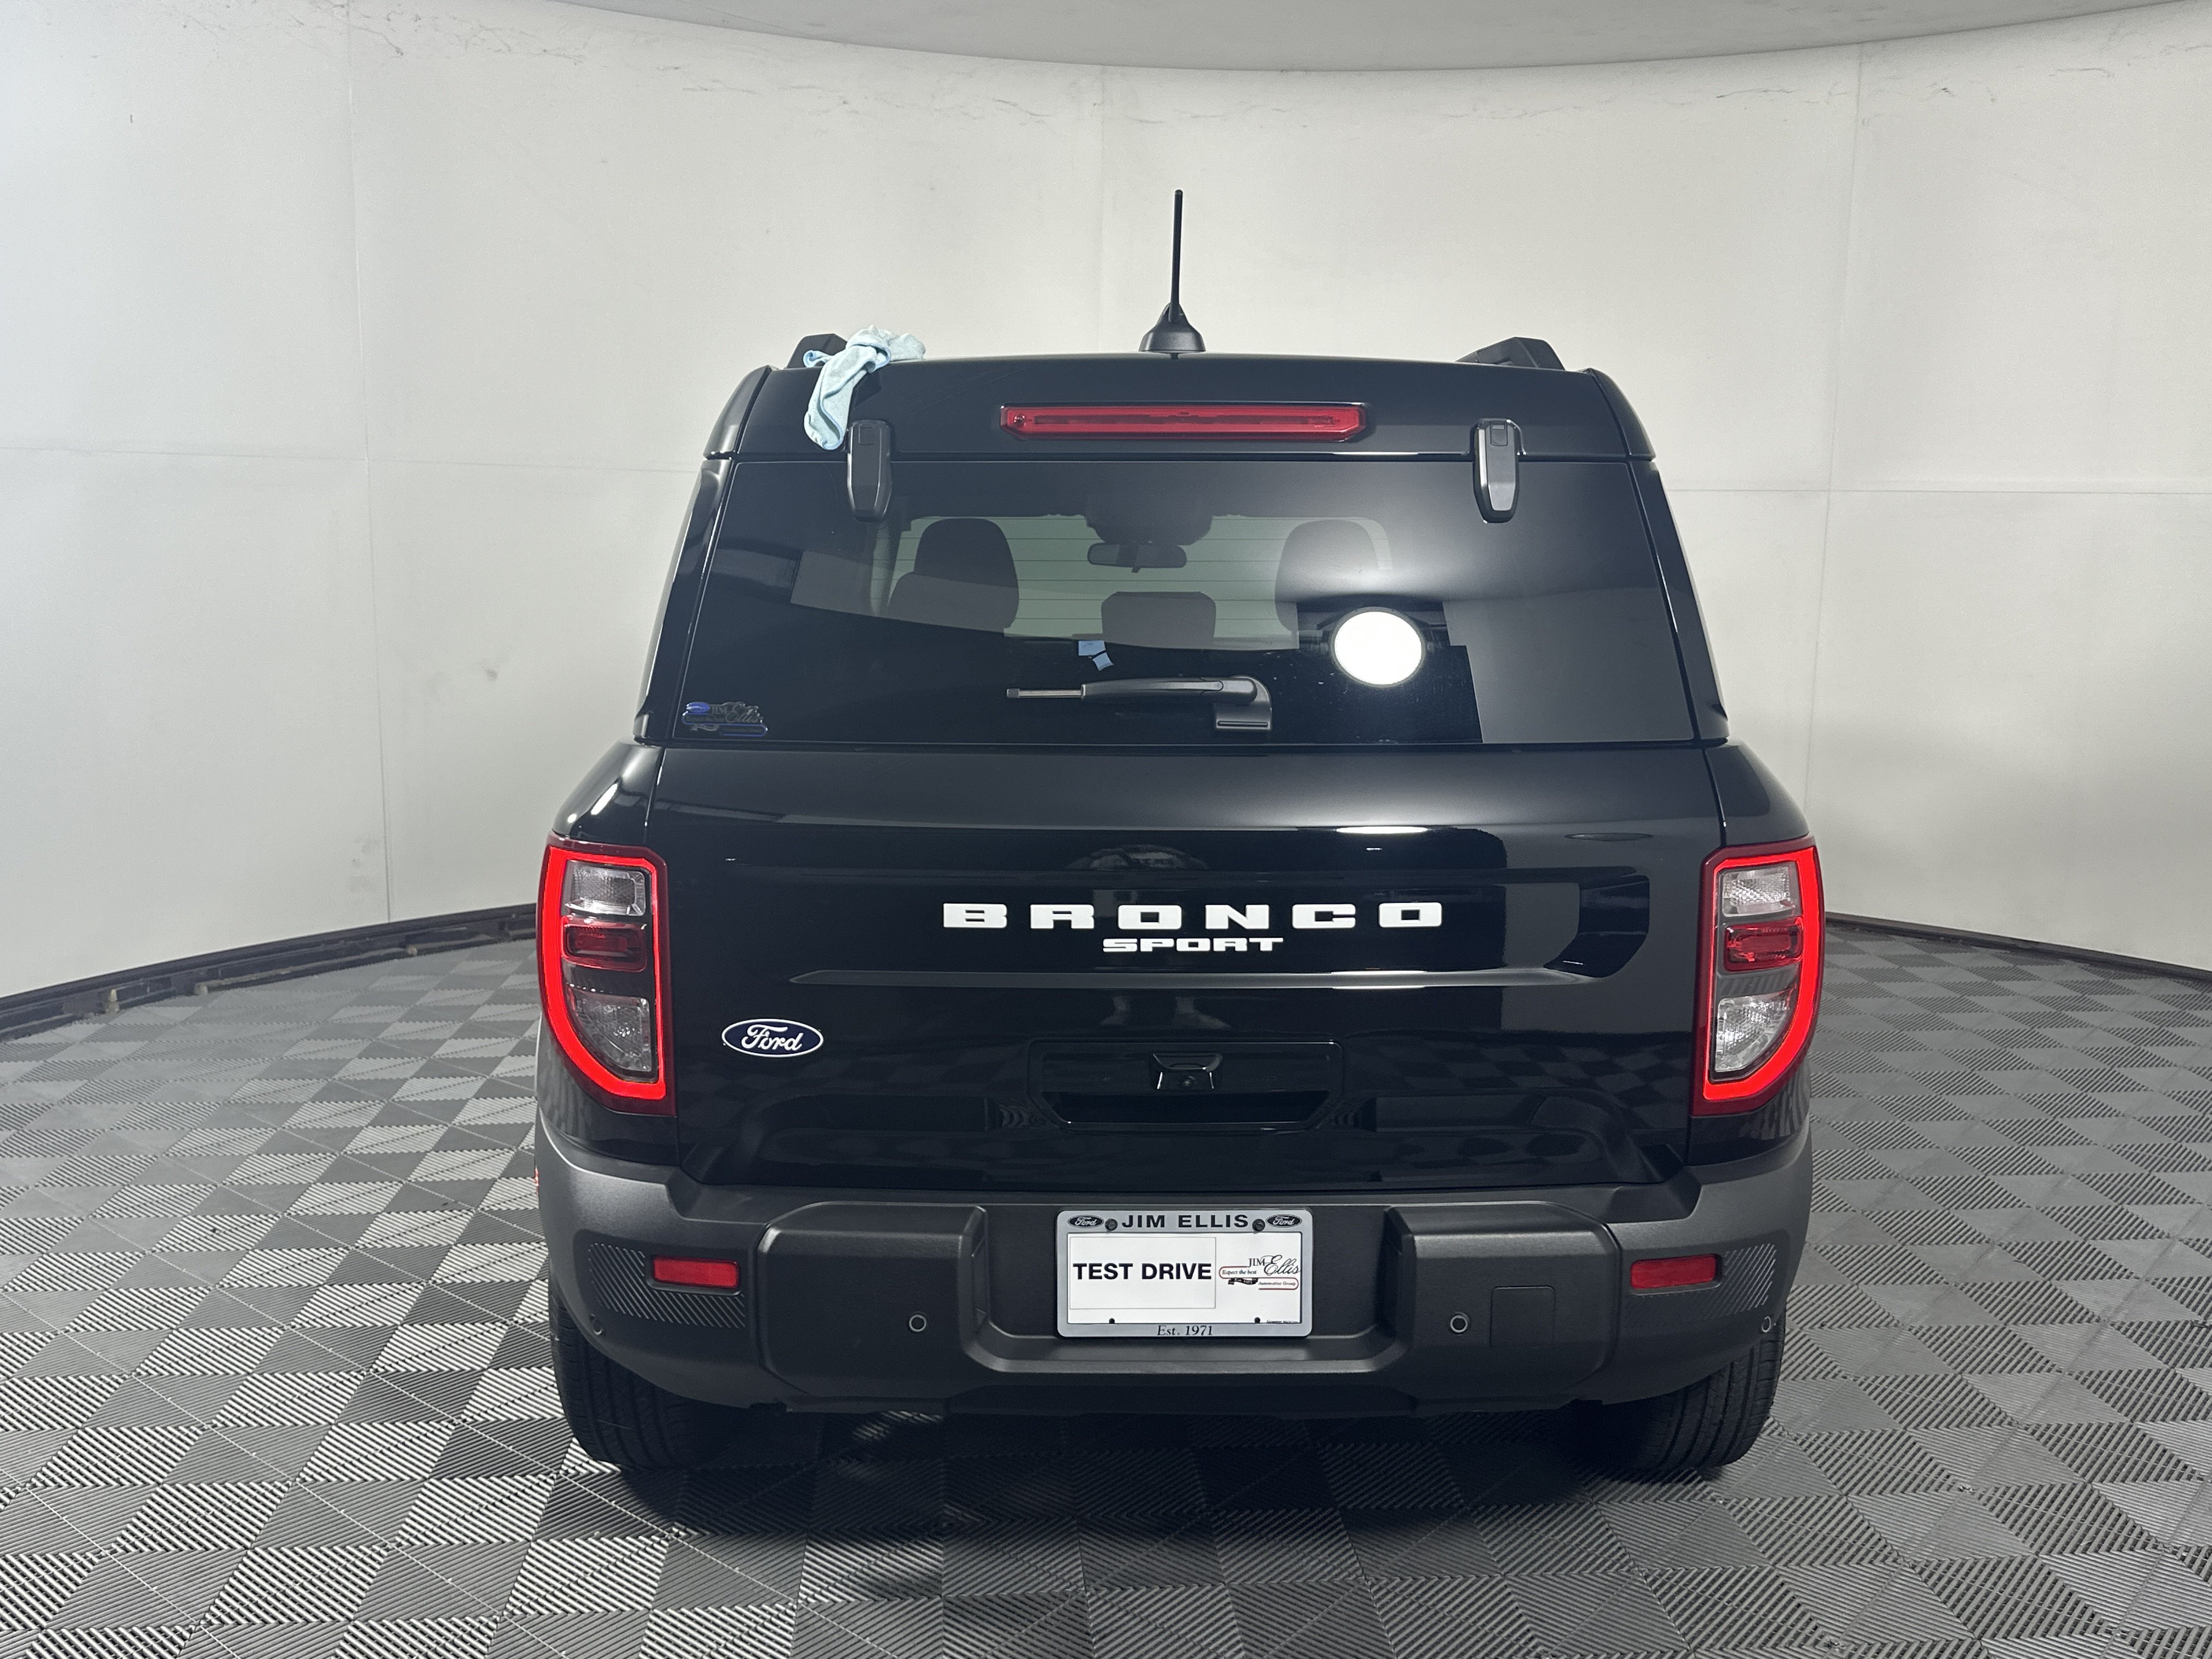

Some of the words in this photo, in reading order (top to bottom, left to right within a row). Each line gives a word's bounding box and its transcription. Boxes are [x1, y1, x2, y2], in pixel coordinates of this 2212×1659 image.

[943, 902, 1442, 929] BRONCO
[1103, 938, 1284, 952] SPORT
[741, 1024, 804, 1051] Ford
[1074, 1217, 1097, 1226] Ford
[1122, 1215, 1165, 1228] JIM
[1178, 1214, 1249, 1228] ELLIS
[1272, 1215, 1295, 1226] Ford
[1073, 1263, 1133, 1280] TEST
[1141, 1262, 1212, 1280] DRIVE
[1248, 1258, 1266, 1267] JIM
[1263, 1254, 1300, 1276] Ellis
[1156, 1325, 1180, 1336] Est.
[1185, 1325, 1214, 1336] 1971
